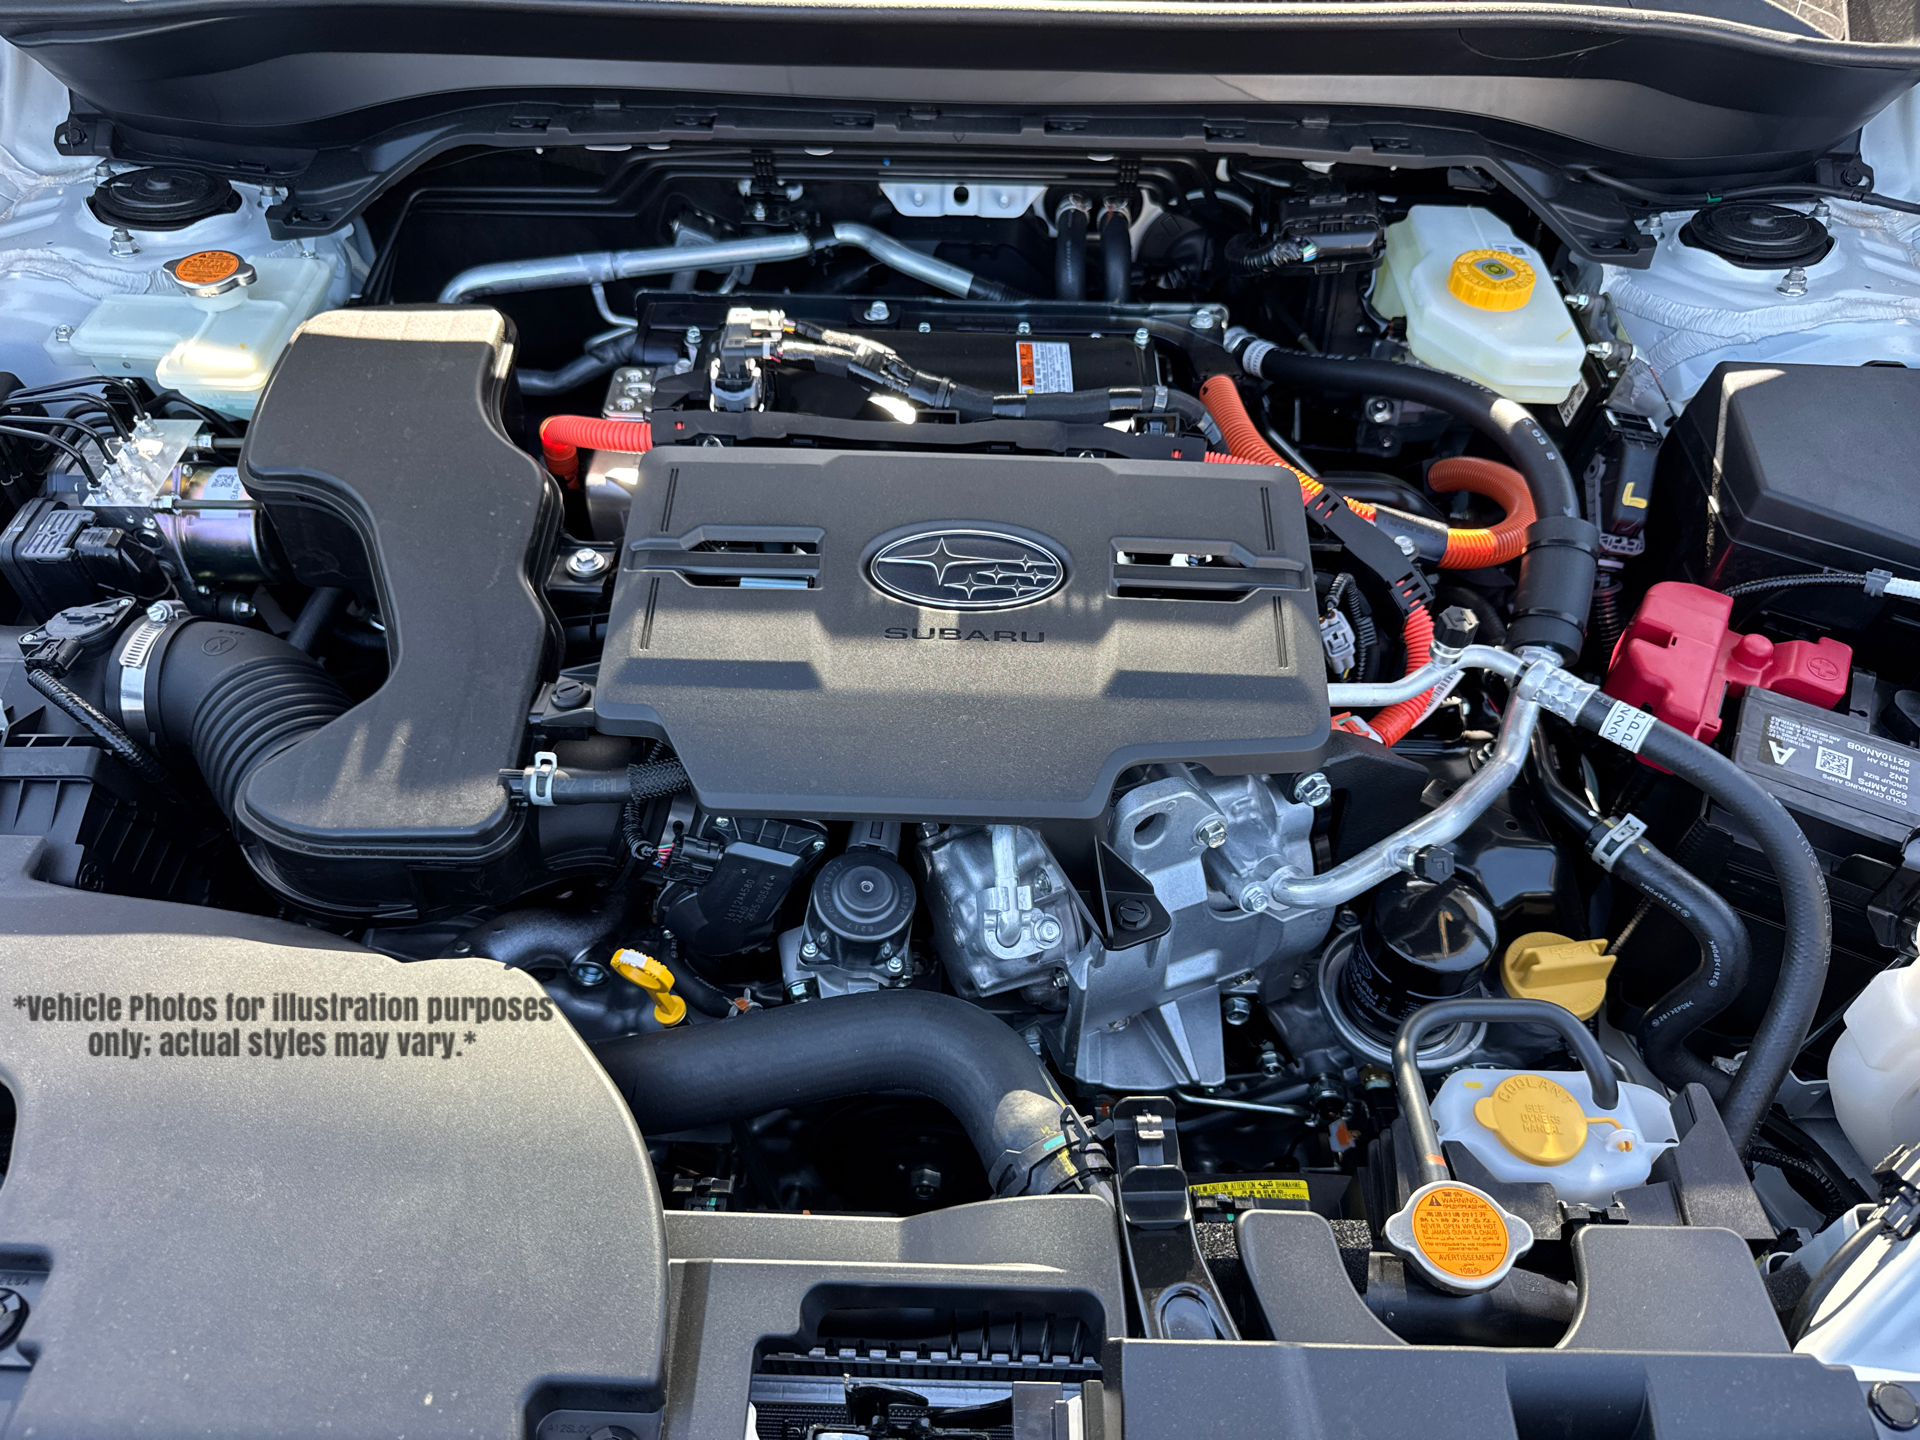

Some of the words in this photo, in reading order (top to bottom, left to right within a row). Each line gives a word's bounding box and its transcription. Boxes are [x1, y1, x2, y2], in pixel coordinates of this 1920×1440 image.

[884, 628, 1044, 642] SUBARU
[1613, 715, 1624, 727] 2
[1627, 721, 1639, 731] P
[1771, 716, 1800, 729] MATERIALS
[1608, 727, 1618, 737] 2
[1621, 733, 1633, 741] P
[1800, 725, 1828, 738] IMPORTED
[1776, 734, 1810, 749] DISTRIBUTED
[1819, 736, 1834, 744] MADE
[1768, 740, 1796, 765] A
[1847, 742, 1910, 767] 82110AN00B
[1864, 771, 1879, 780] SIZE
[1890, 764, 1909, 774] 20HR
[1822, 774, 1843, 785] AMPS
[1881, 778, 1908, 790] GROUP
[1889, 772, 1908, 783] LN2
[1845, 781, 1884, 798] CRANKING
[1858, 778, 1887, 792] AMPS
[1886, 795, 1906, 805] COLD
[1890, 789, 1907, 799] 620
[724, 879, 755, 922] 16112AA580
[1498, 1078, 1573, 1103] COOLANT
[1525, 1104, 1545, 1112] SEE
[1524, 1124, 1563, 1135] MANUAL
[1231, 1182, 1256, 1190] ATTENTION
